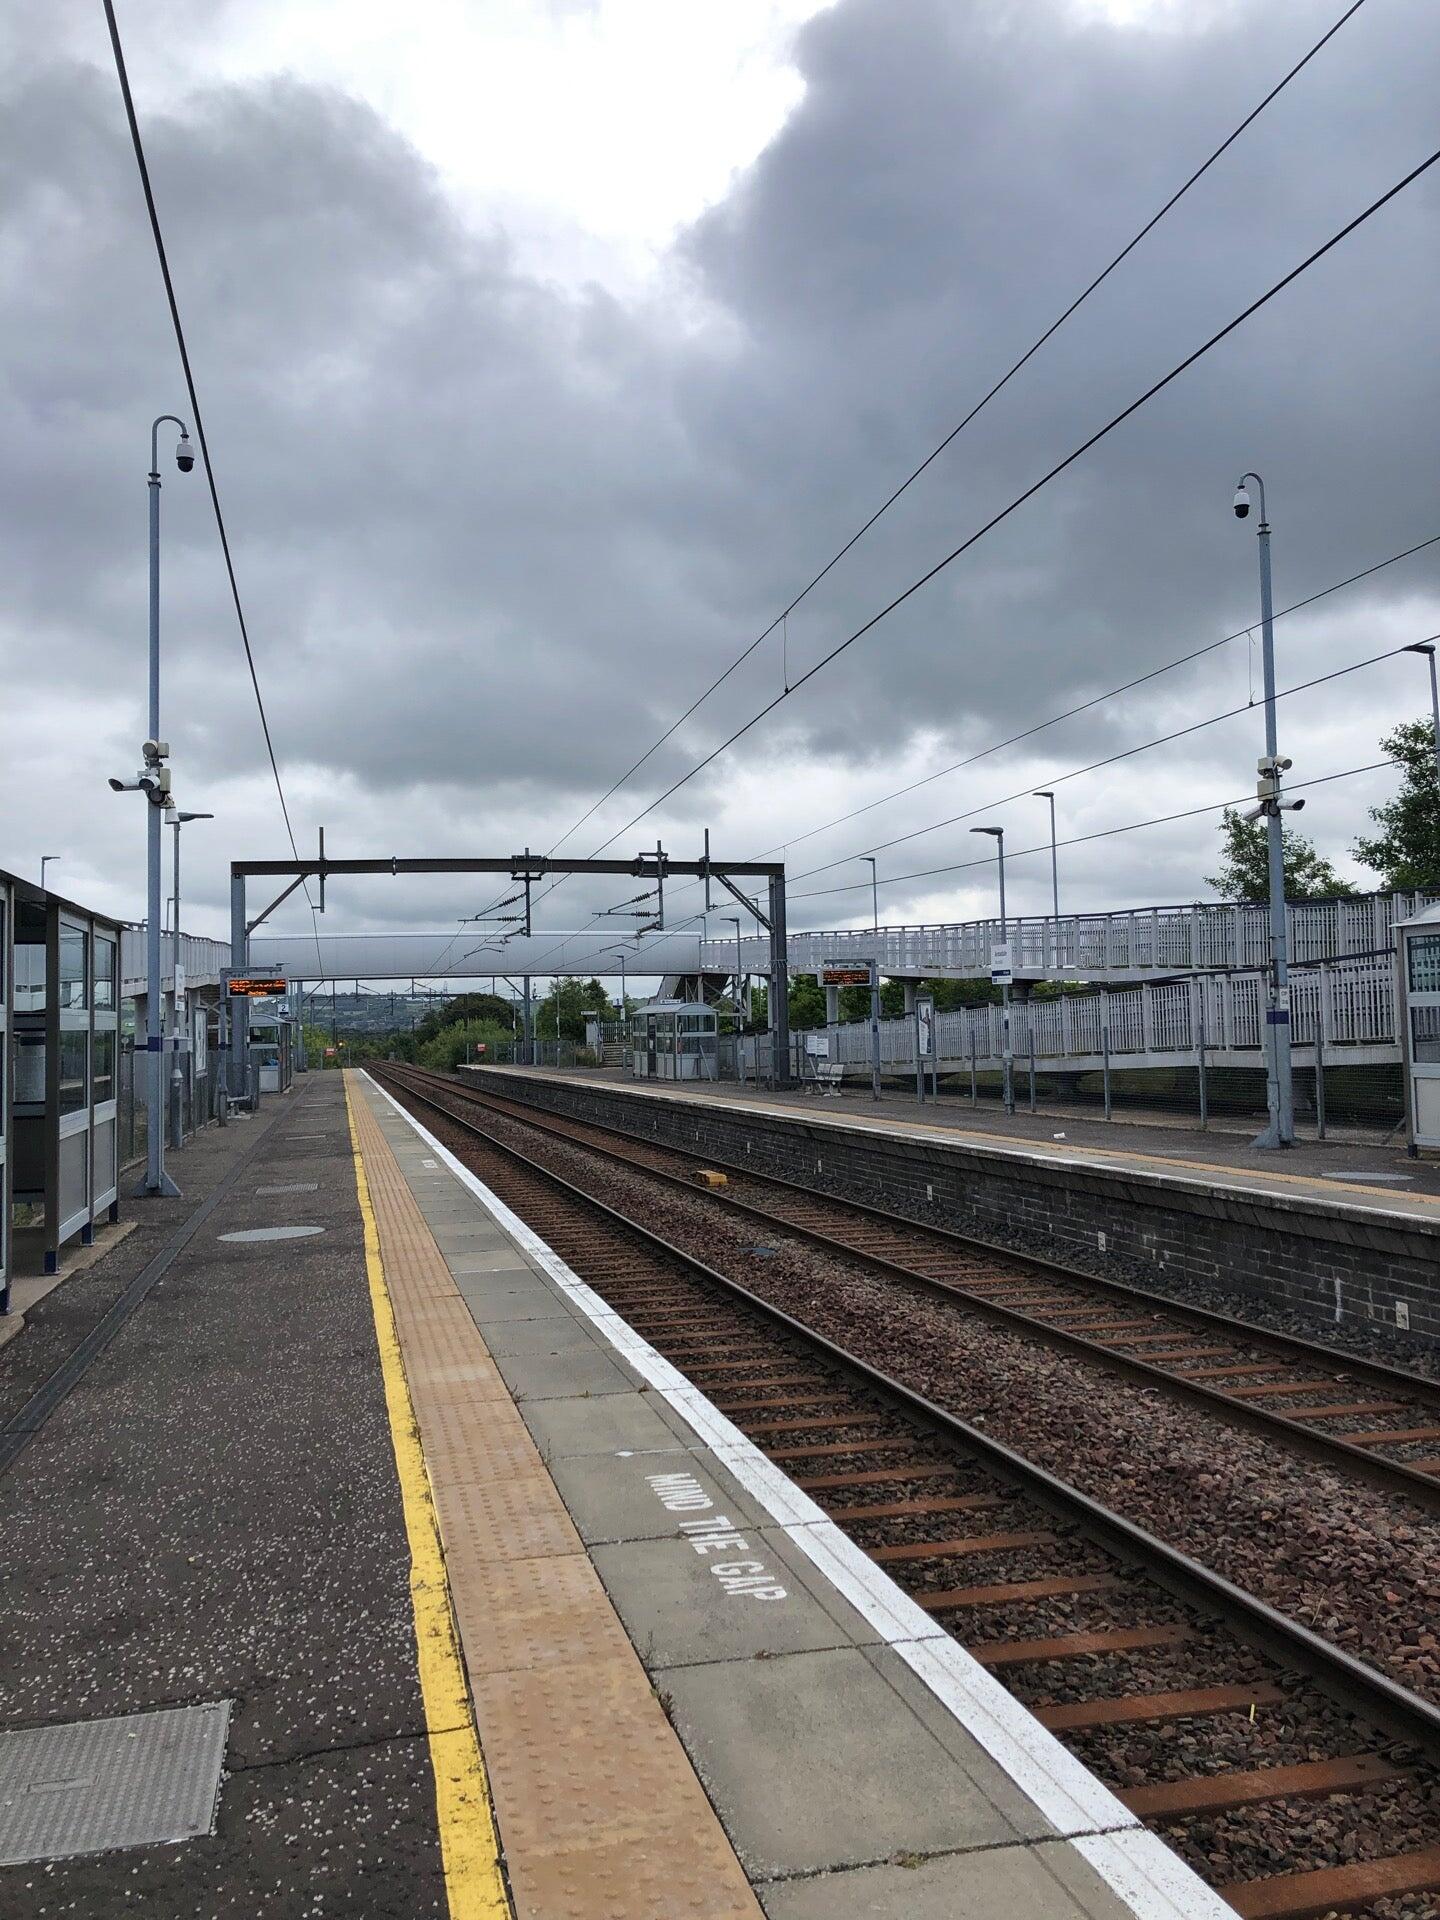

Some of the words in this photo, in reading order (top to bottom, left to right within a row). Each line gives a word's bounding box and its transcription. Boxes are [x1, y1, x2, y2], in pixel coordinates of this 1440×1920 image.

[645, 1473, 714, 1511] MIND
[678, 1516, 750, 1555] THE
[710, 1560, 788, 1601] GAP
